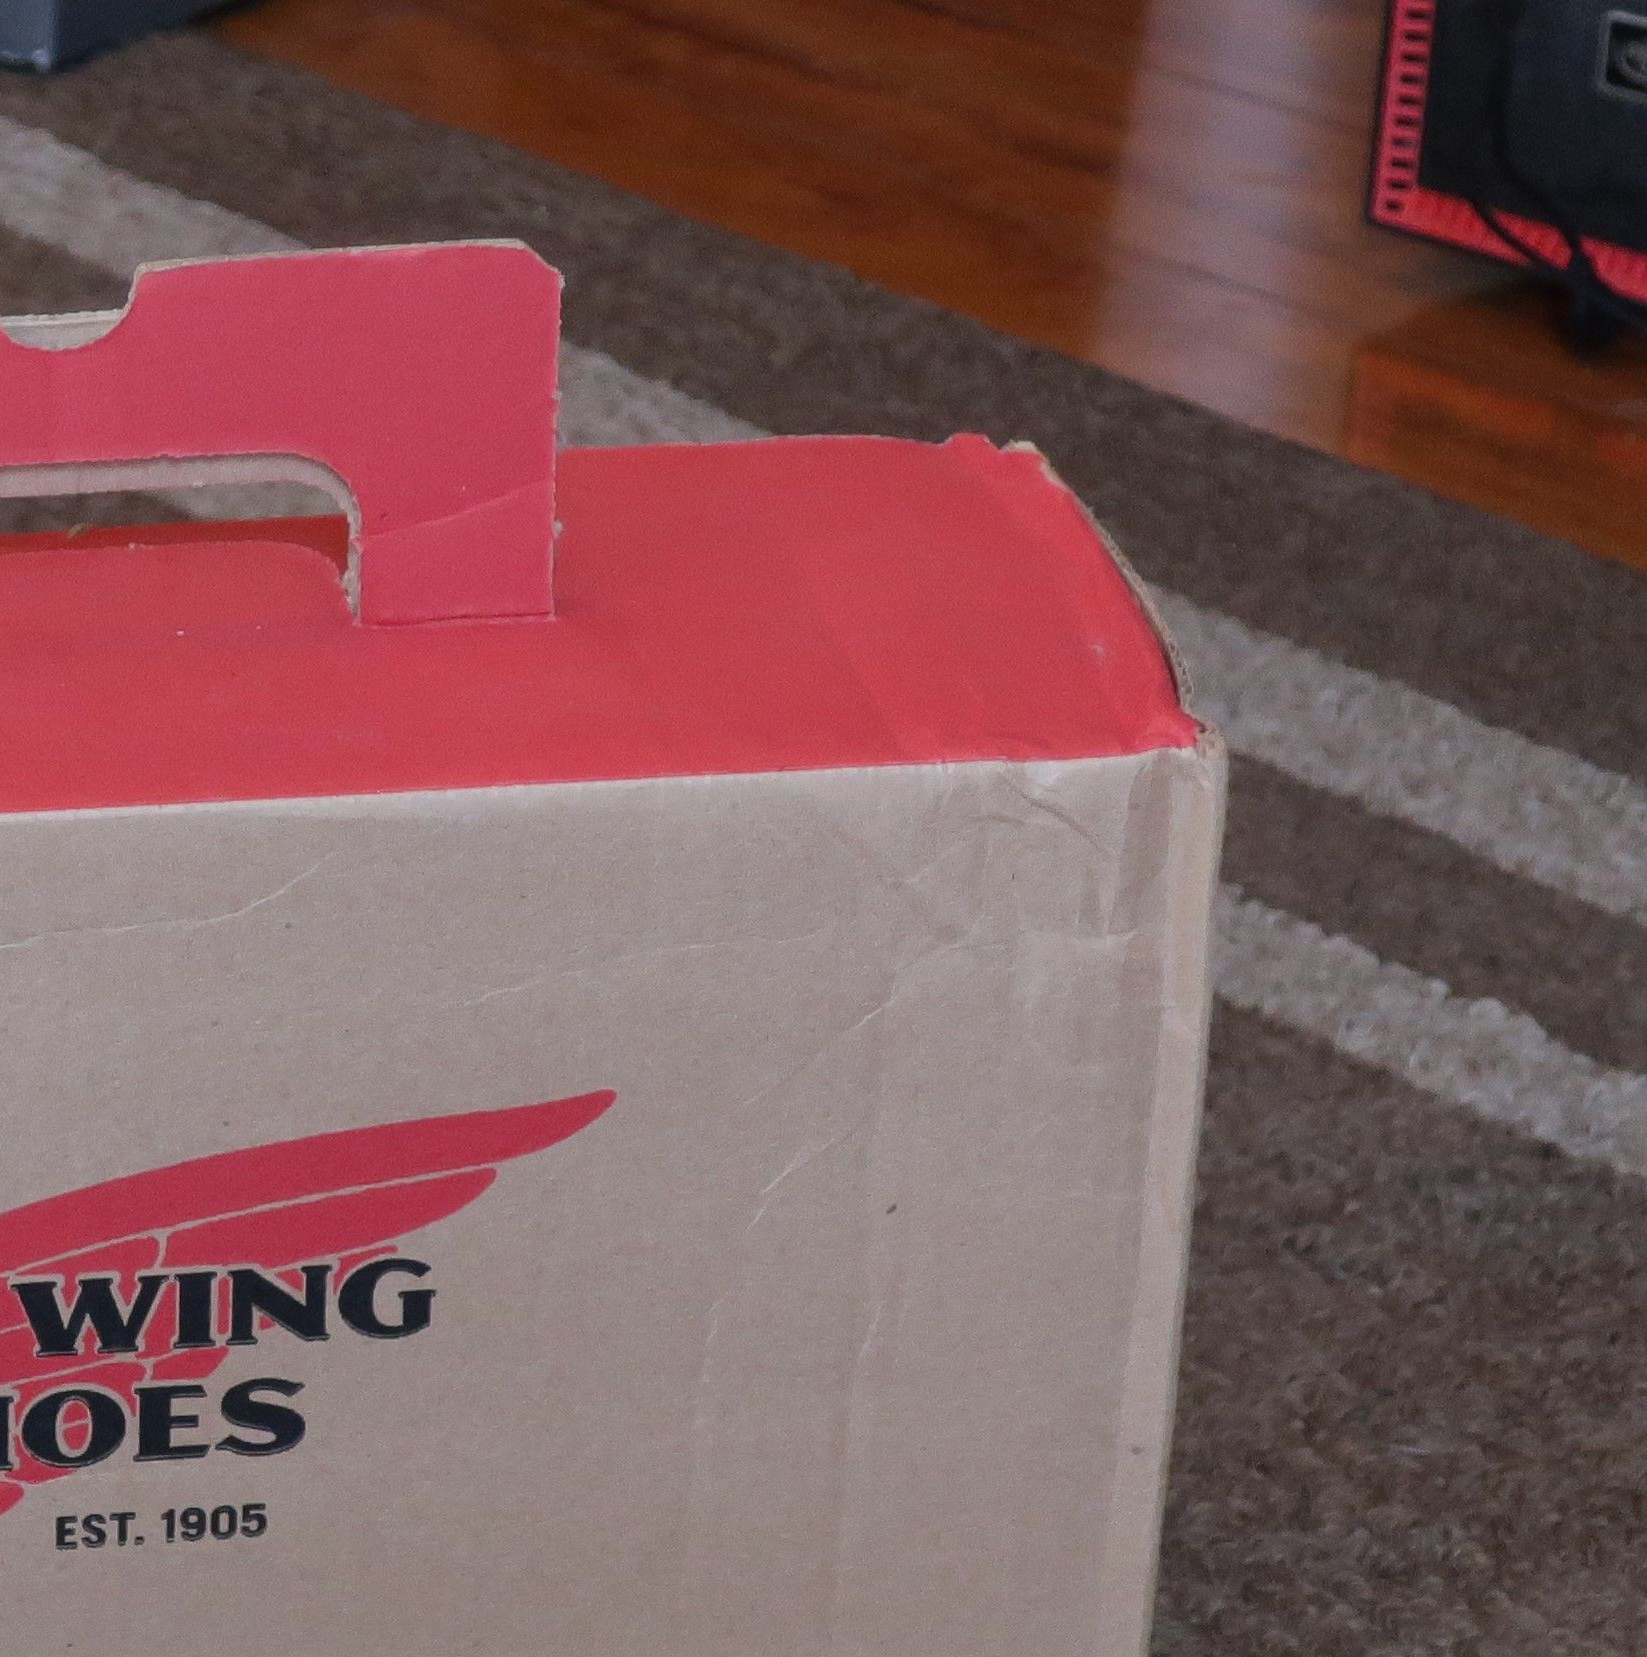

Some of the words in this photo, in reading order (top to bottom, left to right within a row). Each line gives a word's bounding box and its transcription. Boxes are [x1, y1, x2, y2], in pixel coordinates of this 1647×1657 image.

[13, 1258, 436, 1356] WING
[54, 1511, 145, 1551] EST.
[162, 1503, 268, 1544] 1905
